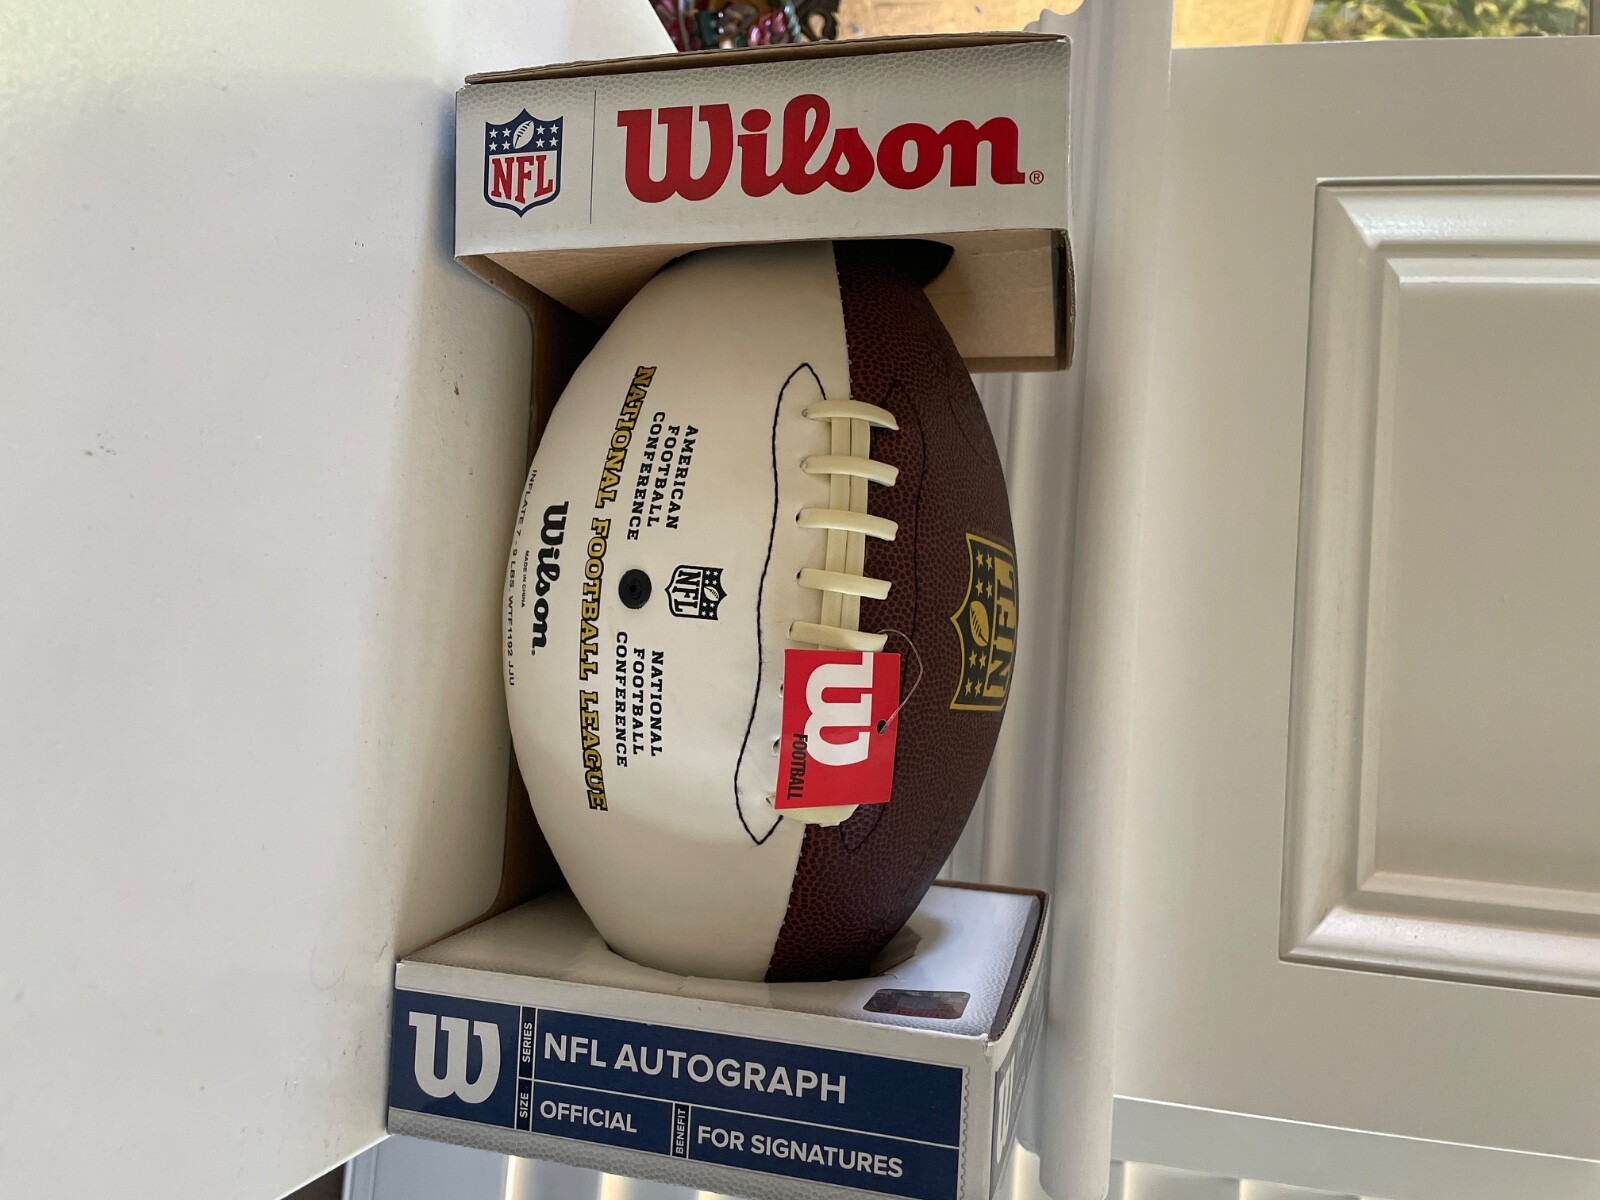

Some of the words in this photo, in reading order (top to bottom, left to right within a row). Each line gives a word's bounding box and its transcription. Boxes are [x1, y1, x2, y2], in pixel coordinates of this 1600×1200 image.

[490, 154, 553, 204] NFL
[617, 94, 1026, 203] Wilson
[595, 366, 657, 508] NATIONAL
[627, 412, 666, 540] CONFERENCE
[647, 425, 680, 527] FOOTBALL
[666, 425, 699, 529] AMERICAN
[518, 469, 537, 525] INFLATE
[532, 501, 569, 648] Wilson
[579, 517, 611, 681] FOOTBALL
[674, 569, 703, 613] NFL
[983, 557, 1018, 698] NFL
[579, 690, 608, 811] LEAGUE
[615, 631, 628, 767] CONFERENCE
[632, 648, 645, 755] FOOTBALL
[650, 650, 664, 757] NATIONAL
[803, 652, 874, 767] W
[788, 733, 808, 800] FOOTBALL
[407, 1010, 501, 1104] W
[522, 1022, 534, 1064] SERIES
[544, 1032, 606, 1068] NFL
[614, 1043, 847, 1104] AUTOGRAPH
[519, 1092, 530, 1119] SIZE
[540, 1100, 638, 1134] OFFICIAL
[675, 1108, 687, 1156] BENEFIT
[697, 1127, 747, 1151] FOR
[751, 1134, 904, 1179] SIGNATURES
